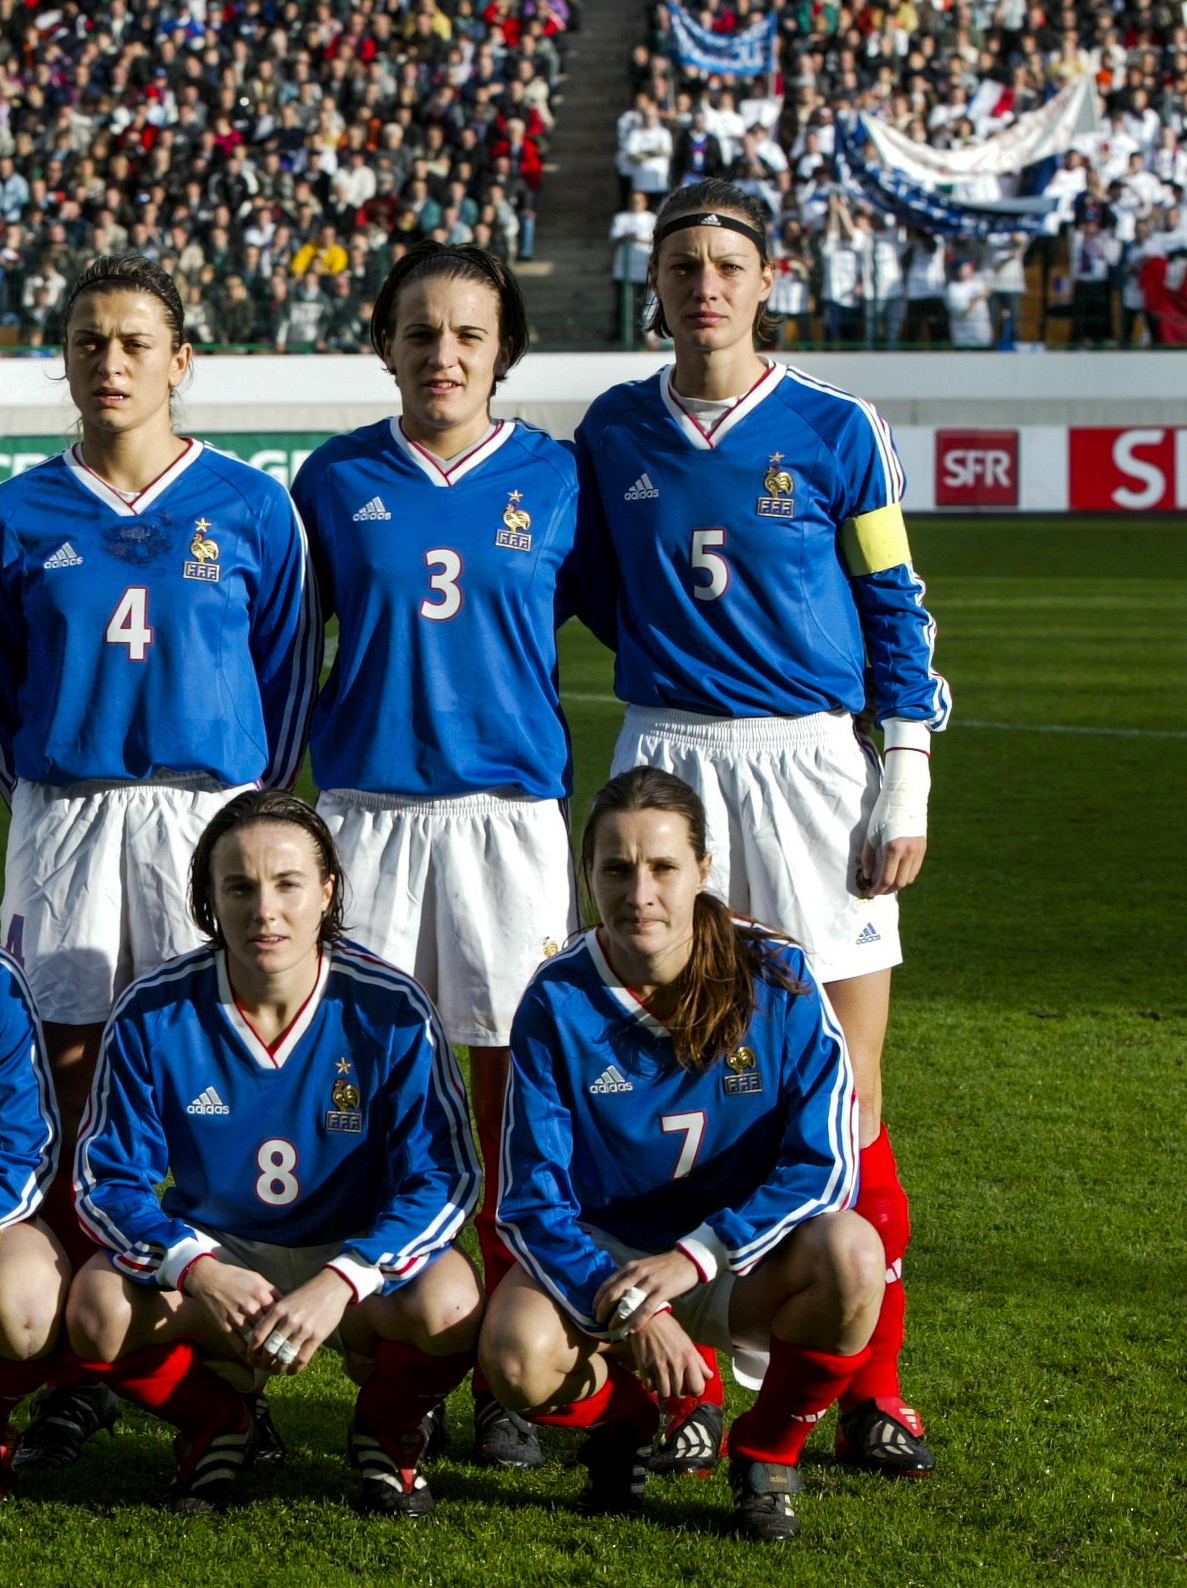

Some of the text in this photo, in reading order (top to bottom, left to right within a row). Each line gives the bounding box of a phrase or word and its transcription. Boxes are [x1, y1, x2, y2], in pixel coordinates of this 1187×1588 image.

[943, 450, 1011, 488] SFR
[624, 489, 660, 501] adidas
[353, 512, 392, 522] adidas
[43, 556, 84, 570] adidas
[691, 528, 729, 601] 5
[419, 547, 463, 621] 3
[105, 586, 153, 661] 4
[855, 933, 881, 945] adidas
[590, 1082, 634, 1095] adidas
[187, 1104, 230, 1115] adidas
[660, 1110, 706, 1180] 7
[255, 1138, 299, 1207] 8
